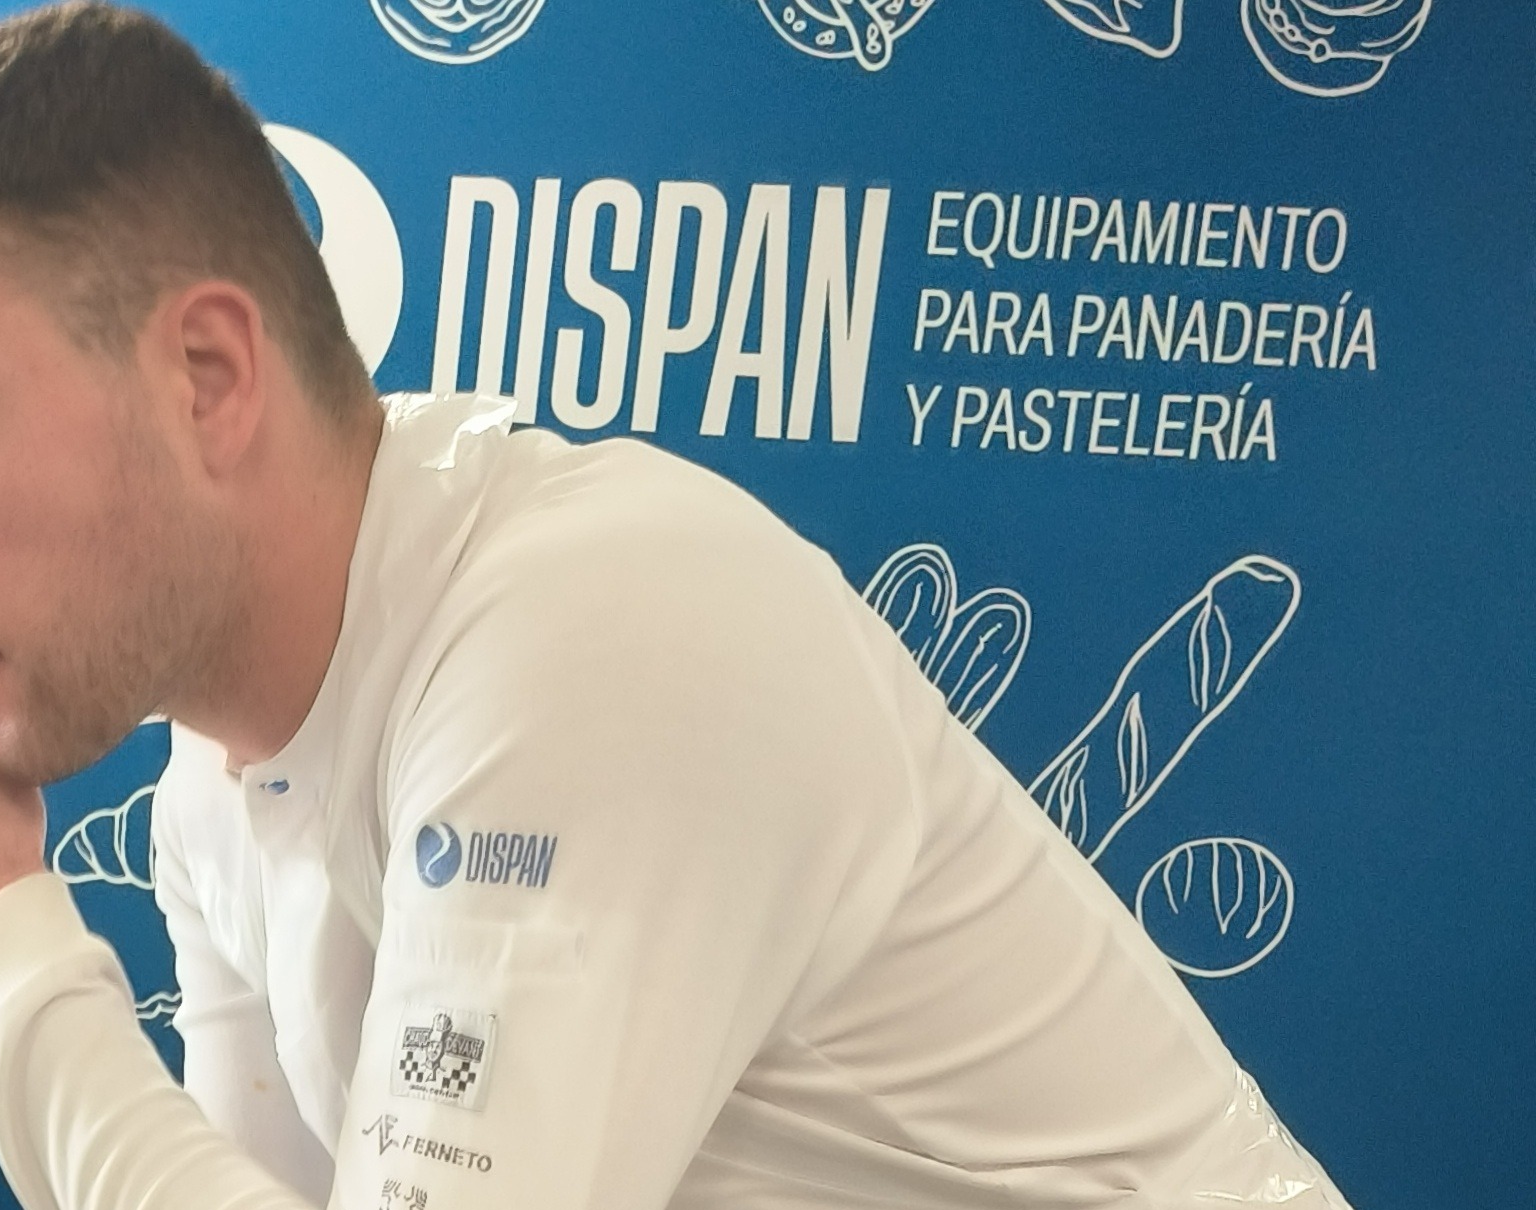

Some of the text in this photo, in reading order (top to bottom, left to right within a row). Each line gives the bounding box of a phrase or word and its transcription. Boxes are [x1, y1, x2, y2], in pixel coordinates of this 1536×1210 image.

[927, 190, 1348, 274] EQUIPAMIENTO
[431, 175, 890, 442] DISPAN
[913, 287, 1377, 371] PARA PANADERÍA
[906, 382, 1277, 461] Y PASTELERÍA
[465, 831, 558, 888] DISPAN
[402, 1134, 493, 1173] FERNETO
